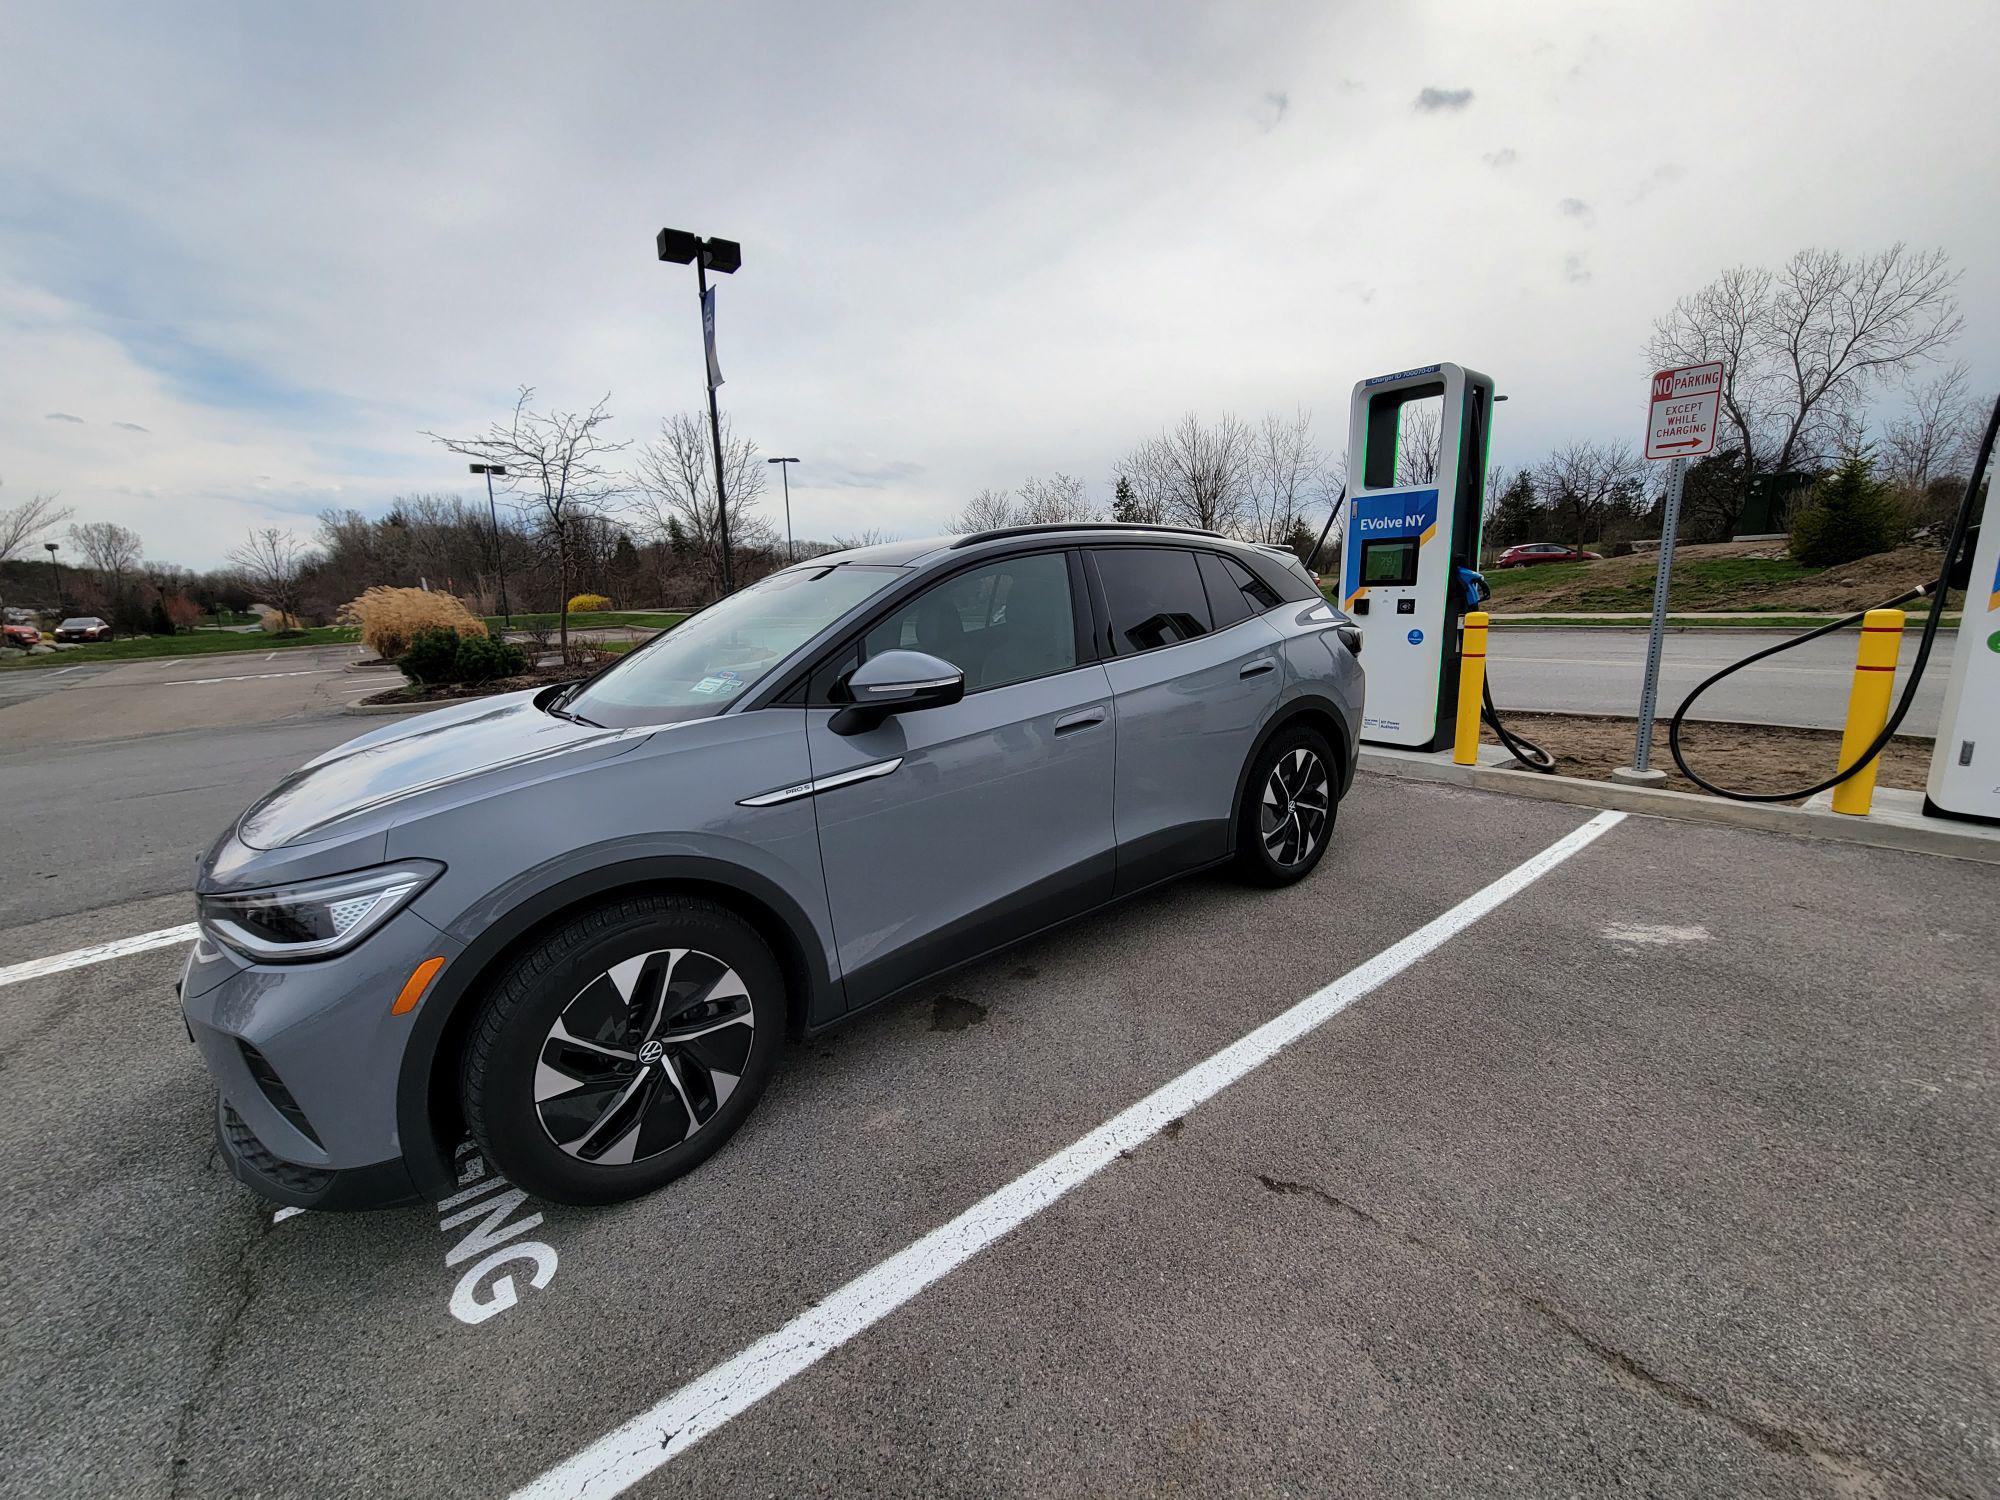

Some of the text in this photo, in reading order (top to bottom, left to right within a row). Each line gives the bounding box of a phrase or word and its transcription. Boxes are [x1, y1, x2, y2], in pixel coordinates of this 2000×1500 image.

[1371, 376, 1394, 384] Charger
[1653, 371, 1719, 396] NO PARKING
[1665, 401, 1703, 415] EXCEPT
[1667, 413, 1698, 426] WHILE
[1656, 423, 1706, 438] CHARGING
[1360, 513, 1426, 531] EVolve NY
[785, 786, 803, 795] PRO
